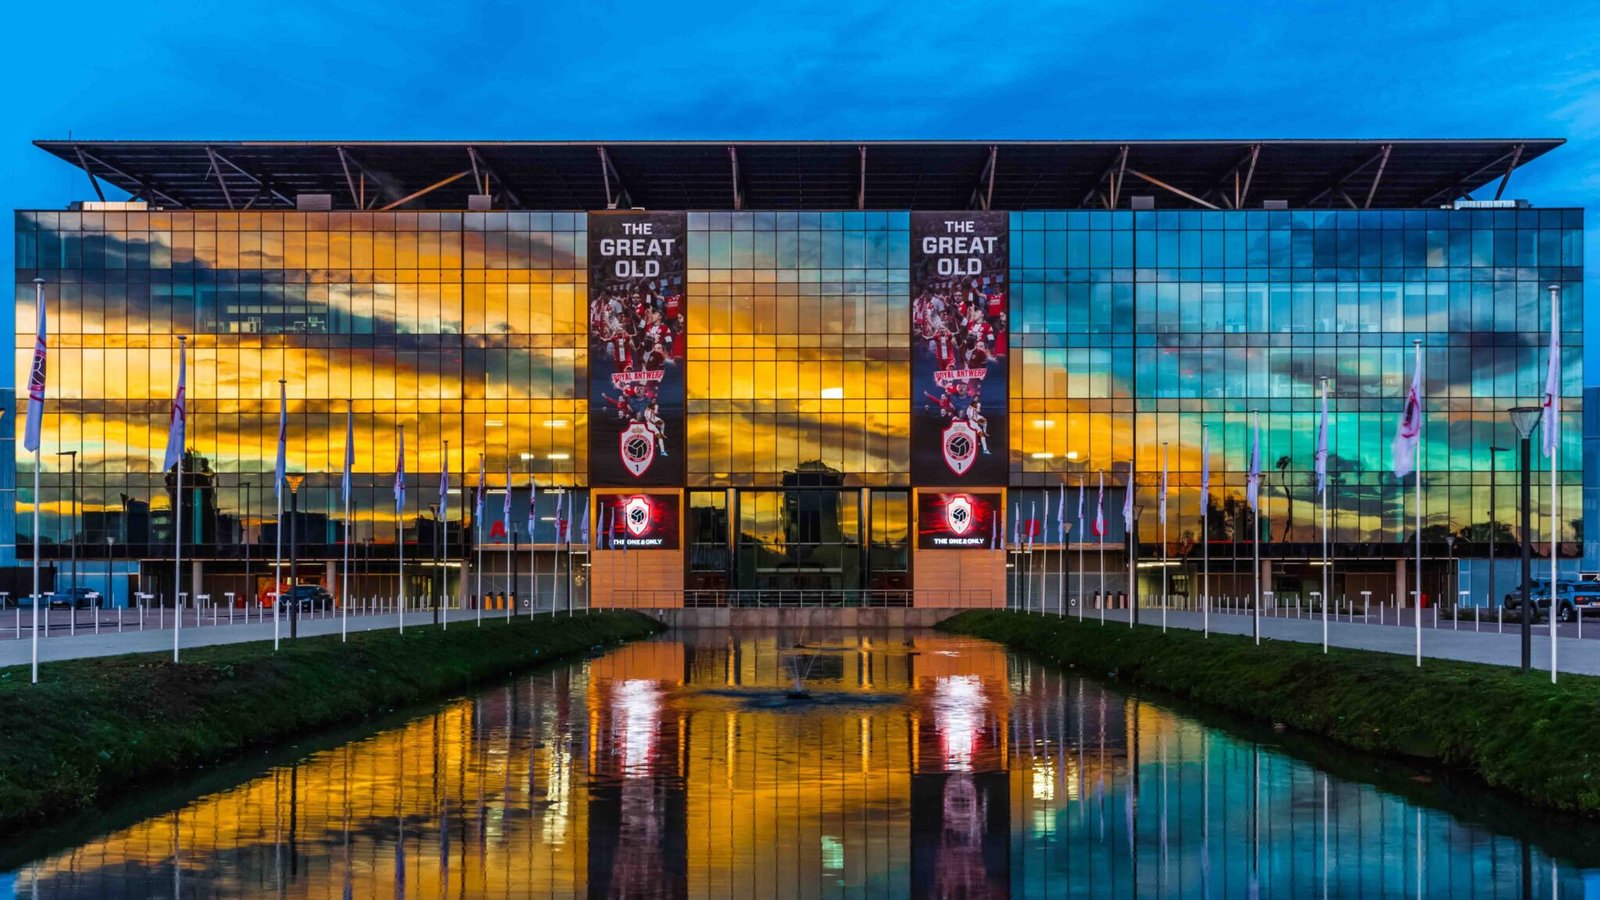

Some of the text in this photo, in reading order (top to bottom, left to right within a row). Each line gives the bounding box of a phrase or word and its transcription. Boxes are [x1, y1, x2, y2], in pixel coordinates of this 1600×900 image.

[622, 223, 652, 235] THE
[944, 221, 975, 233] THE
[600, 238, 676, 256] GREAT
[922, 236, 998, 254] GREAT
[615, 260, 660, 277] OLD
[937, 258, 982, 275] OLD
[634, 370, 664, 380] ANTWERP
[957, 368, 986, 378] ANTWERP
[635, 464, 640, 472] 1
[957, 462, 962, 470] 1
